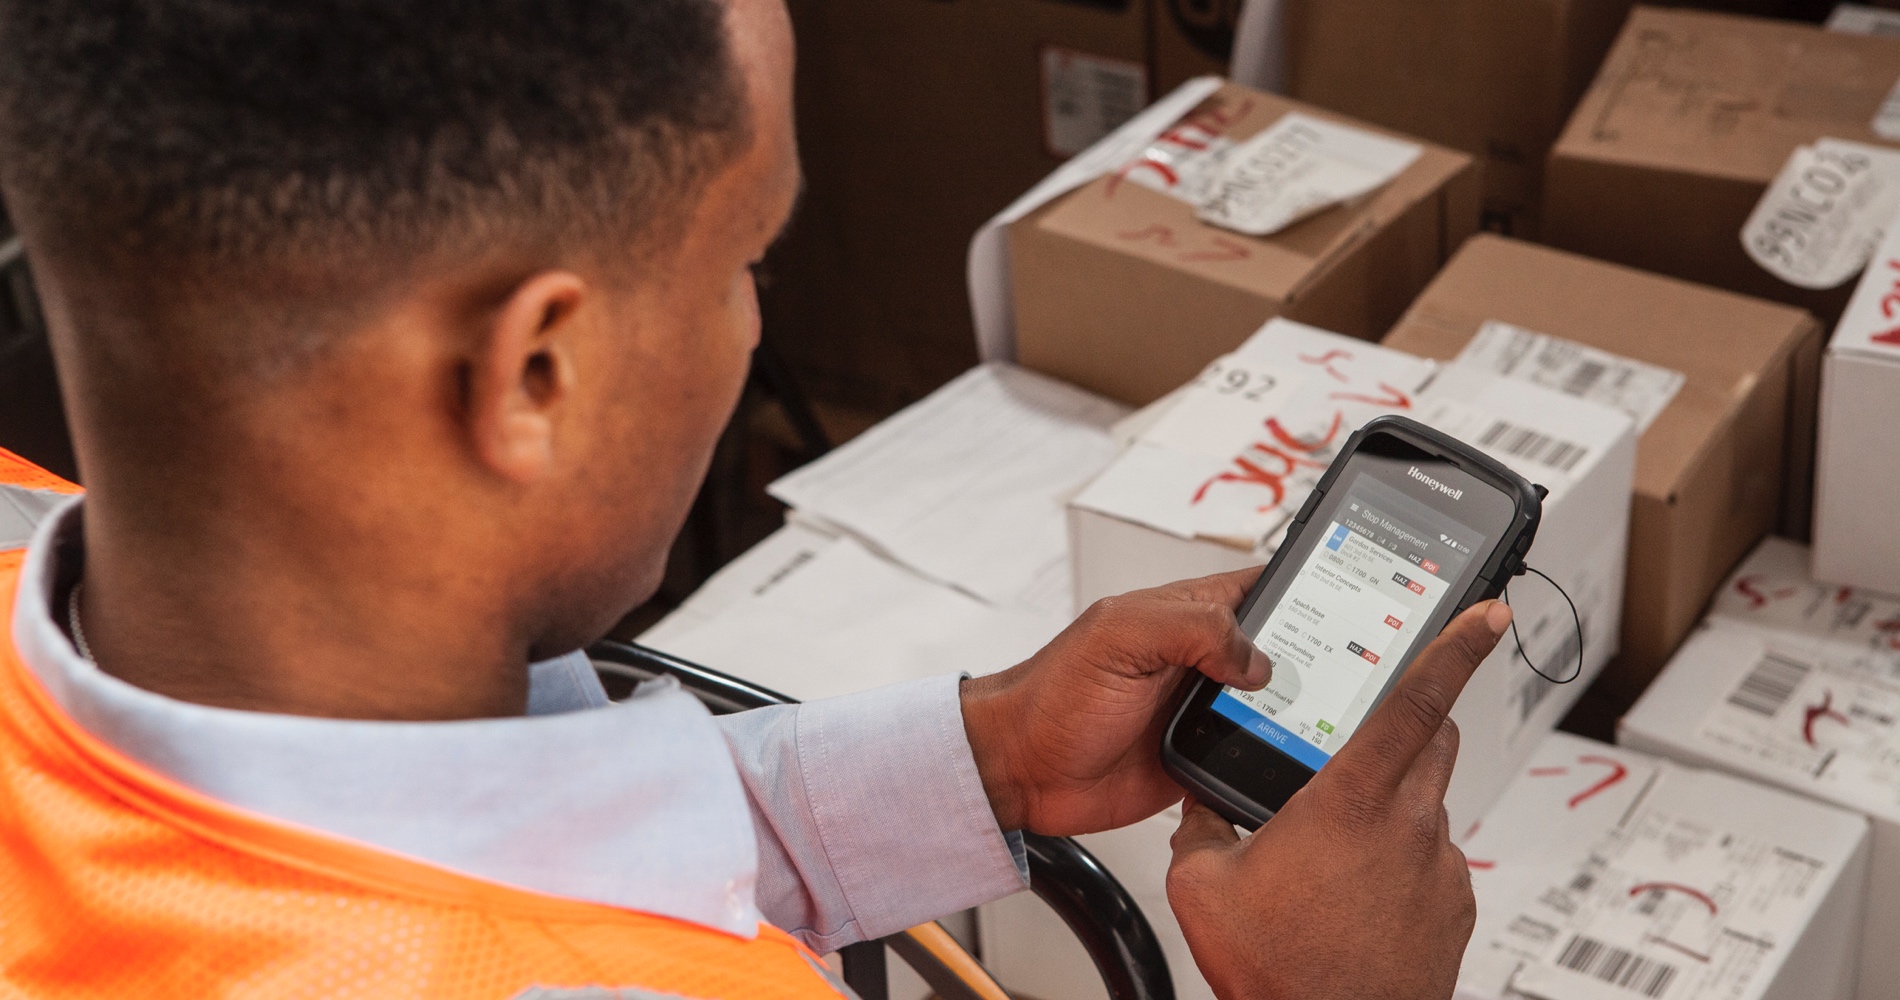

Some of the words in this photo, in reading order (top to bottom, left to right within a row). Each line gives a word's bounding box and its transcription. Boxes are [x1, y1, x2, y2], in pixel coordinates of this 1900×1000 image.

[1407, 466, 1464, 500] Honeywell
[1362, 510, 1379, 524] Stop
[1380, 519, 1428, 550] Management
[1340, 549, 1353, 558] Dock
[1344, 519, 1375, 538] 12345678
[1408, 554, 1422, 564] HAZ
[1424, 562, 1436, 571] POI
[1348, 536, 1370, 550] Gordon
[1369, 547, 1394, 564] Services
[1315, 564, 1336, 578] Interior
[1336, 575, 1361, 592] Concepts
[1328, 554, 1344, 566] 0800
[1351, 567, 1367, 578] 1700
[1369, 577, 1380, 585] GN
[1394, 575, 1408, 585] HAZ
[1410, 584, 1422, 593] POI
[1292, 598, 1310, 610] Apach
[1311, 607, 1325, 619] Rose
[1387, 618, 1399, 627] POI
[1284, 622, 1299, 634] 0800
[1306, 635, 1322, 646] 1700
[1324, 645, 1334, 653] EX
[1262, 645, 1275, 654] Dock
[1277, 646, 1296, 659] Howard
[1295, 656, 1305, 664] Ave
[1289, 642, 1315, 661] Plumbing
[1349, 644, 1362, 654] HAZ
[1365, 653, 1376, 662] POI
[1240, 690, 1254, 702] 1230
[1262, 704, 1277, 716] 1700
[1274, 691, 1286, 701] Road
[1257, 721, 1288, 745] ARRIVE
[1311, 736, 1322, 745] 150
